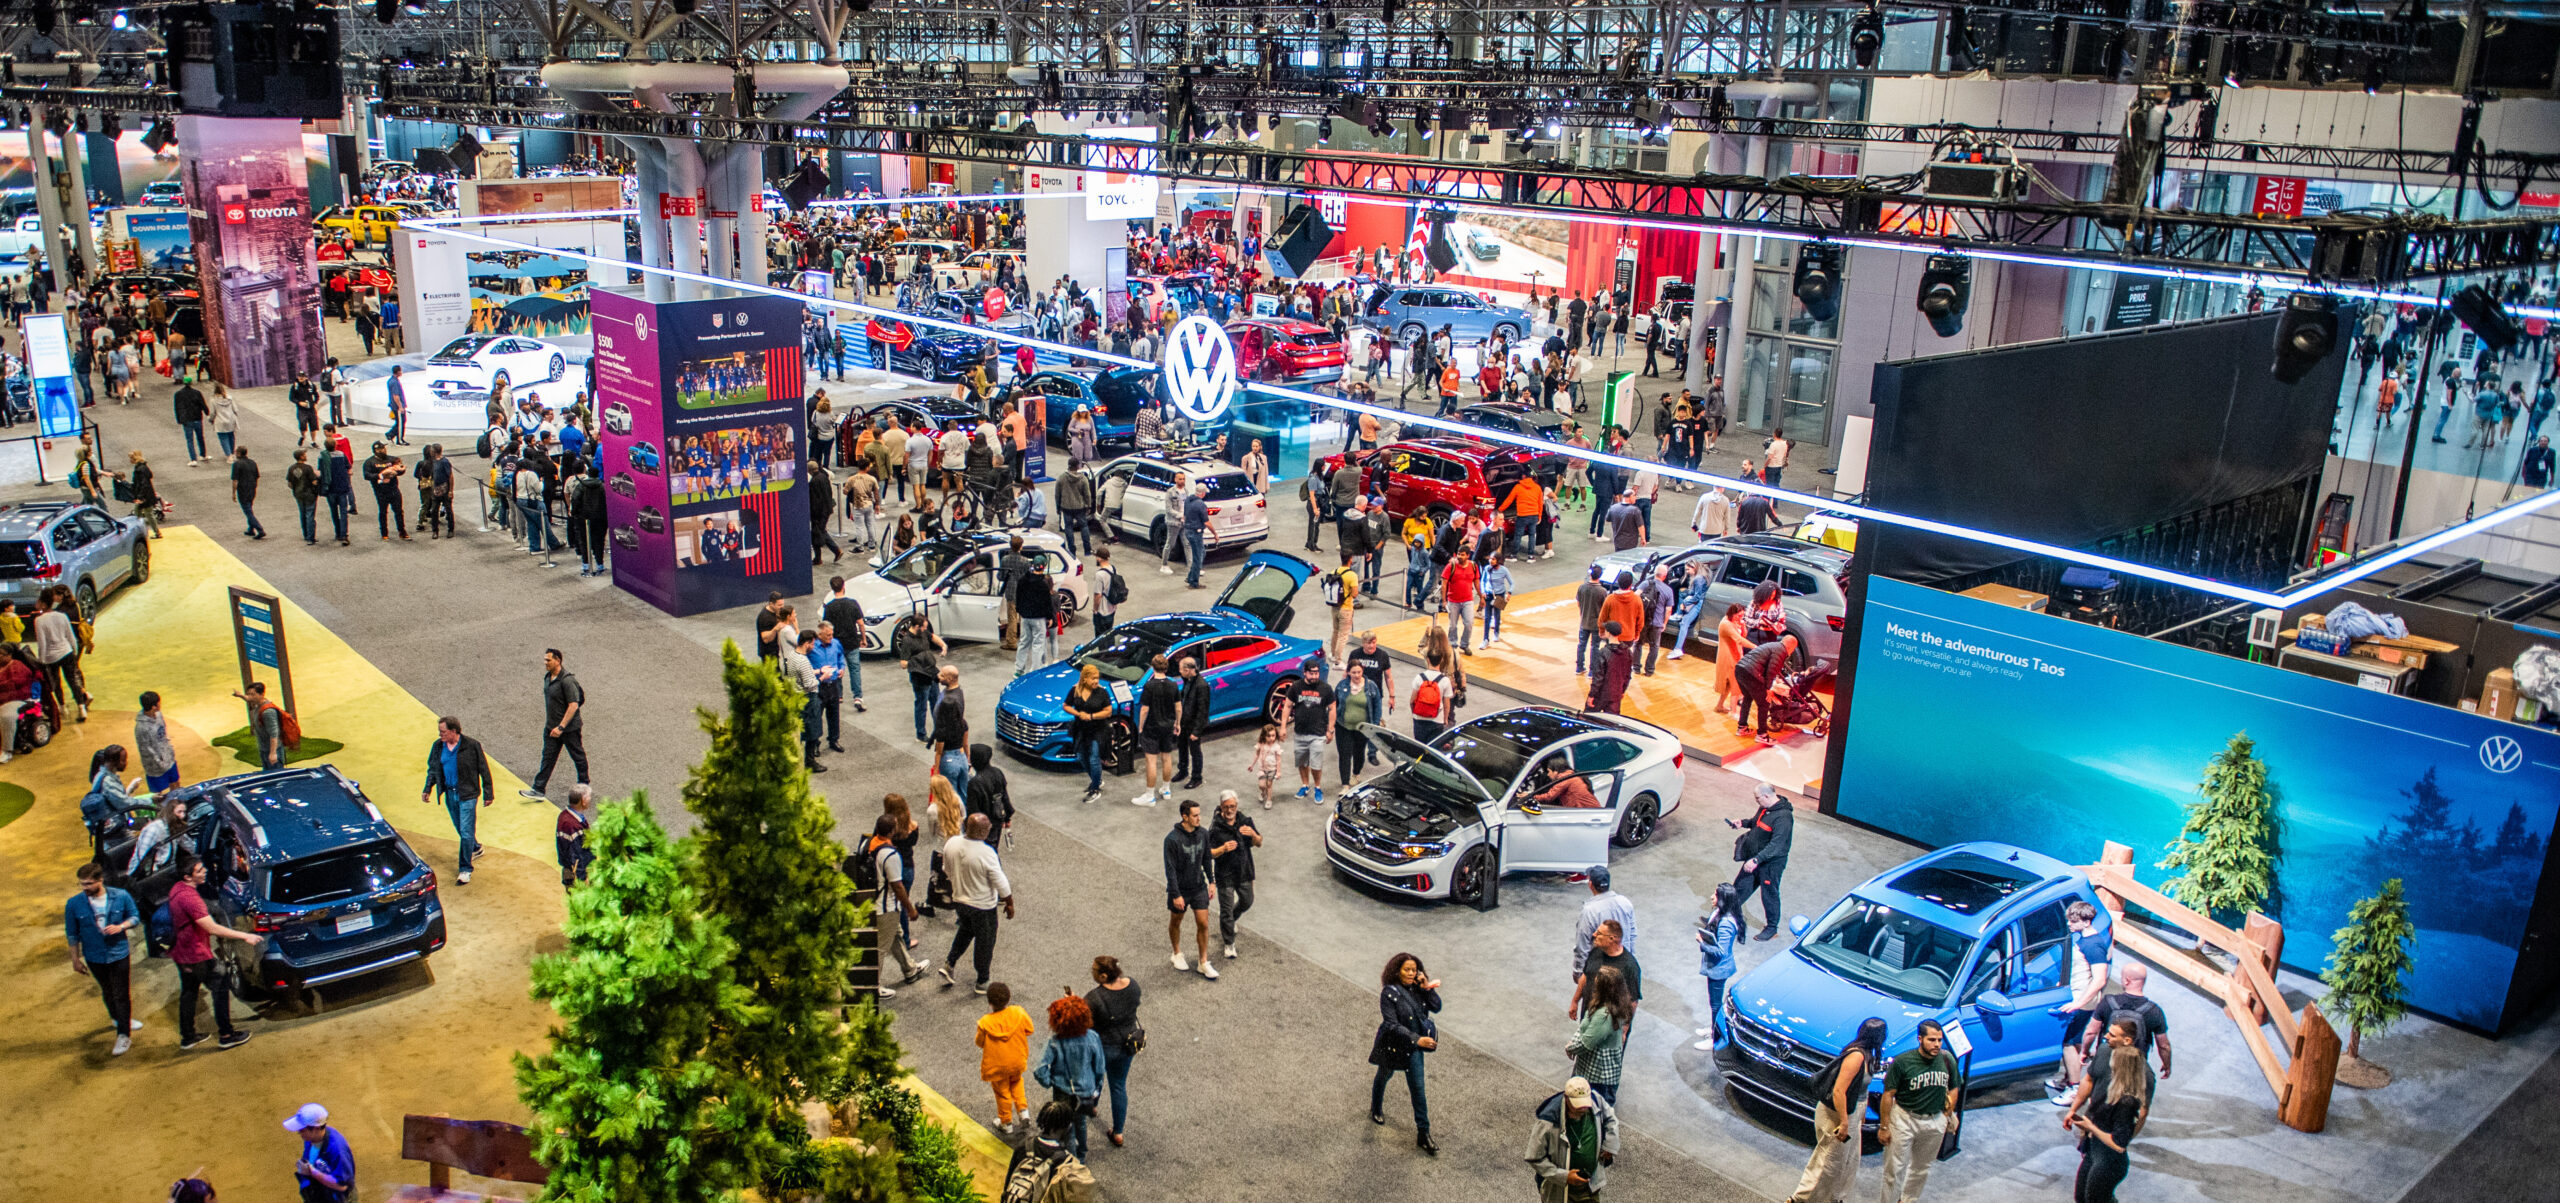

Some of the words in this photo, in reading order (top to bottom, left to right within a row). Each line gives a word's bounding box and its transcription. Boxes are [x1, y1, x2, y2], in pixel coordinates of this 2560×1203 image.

[1041, 177, 1063, 186] TOYOTA
[249, 207, 298, 219] TOYOTA
[132, 225, 156, 233] DOWN
[2128, 292, 2147, 303] PRIUS
[597, 333, 613, 350] $500
[433, 400, 457, 408] PRIUS
[457, 400, 483, 408] PRIME
[1886, 622, 1918, 641] Meet
[1921, 632, 1943, 647] the
[1944, 639, 2029, 668] adventurous
[2032, 657, 2066, 677] Taos
[1882, 648, 1891, 656] to
[1891, 651, 1903, 660] go
[1903, 655, 1942, 670] whenever
[1943, 665, 1958, 675] you
[1959, 668, 1972, 678] are
[1884, 637, 1895, 646] It's
[1896, 641, 1919, 654] smart,
[1921, 648, 1953, 664] versatile,
[1955, 656, 1970, 667] and
[1971, 661, 2000, 674] always
[2000, 668, 2024, 681] ready
[1909, 1070, 1950, 1091] SPRING
